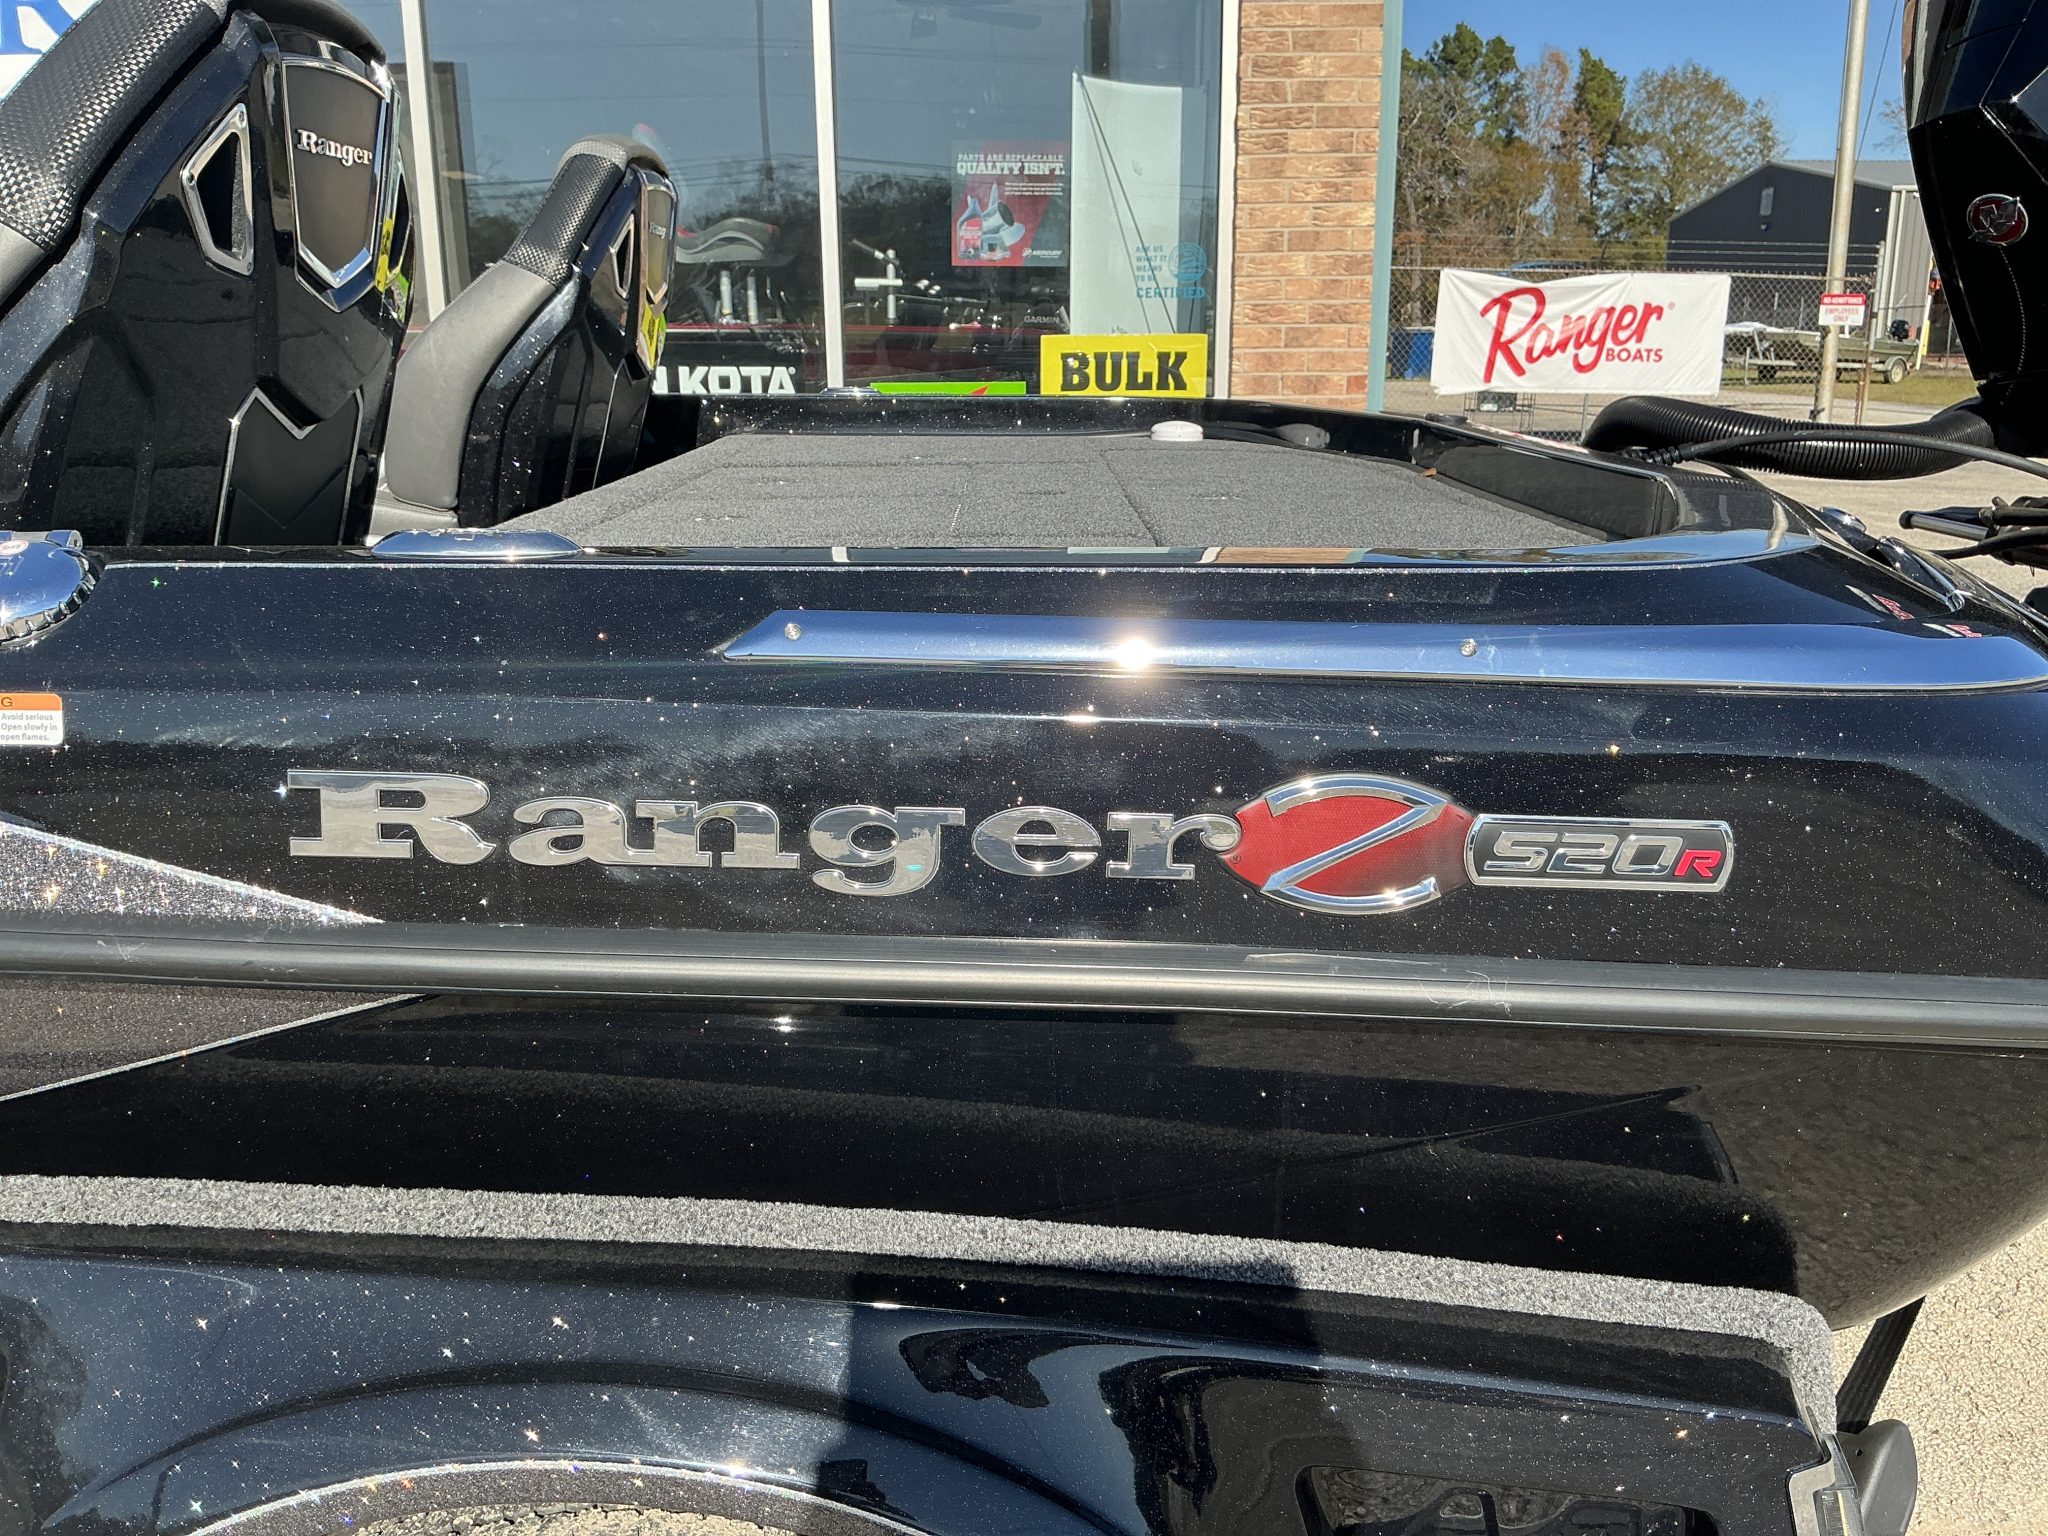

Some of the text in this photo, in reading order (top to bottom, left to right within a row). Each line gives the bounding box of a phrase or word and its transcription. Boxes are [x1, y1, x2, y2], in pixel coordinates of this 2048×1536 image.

[297, 129, 373, 167] Ranger
[957, 162, 1065, 175] QUALITY ISN'T.
[1136, 287, 1205, 299] CERTIFIED
[1024, 316, 1060, 324] GARMIN
[1480, 287, 1664, 384] Ranger
[1605, 348, 1663, 362] BOATS
[1060, 351, 1188, 391] BULK
[1, 723, 58, 732] Open slowly in
[0, 733, 49, 742] open flames.
[287, 769, 1242, 897] Ranger
